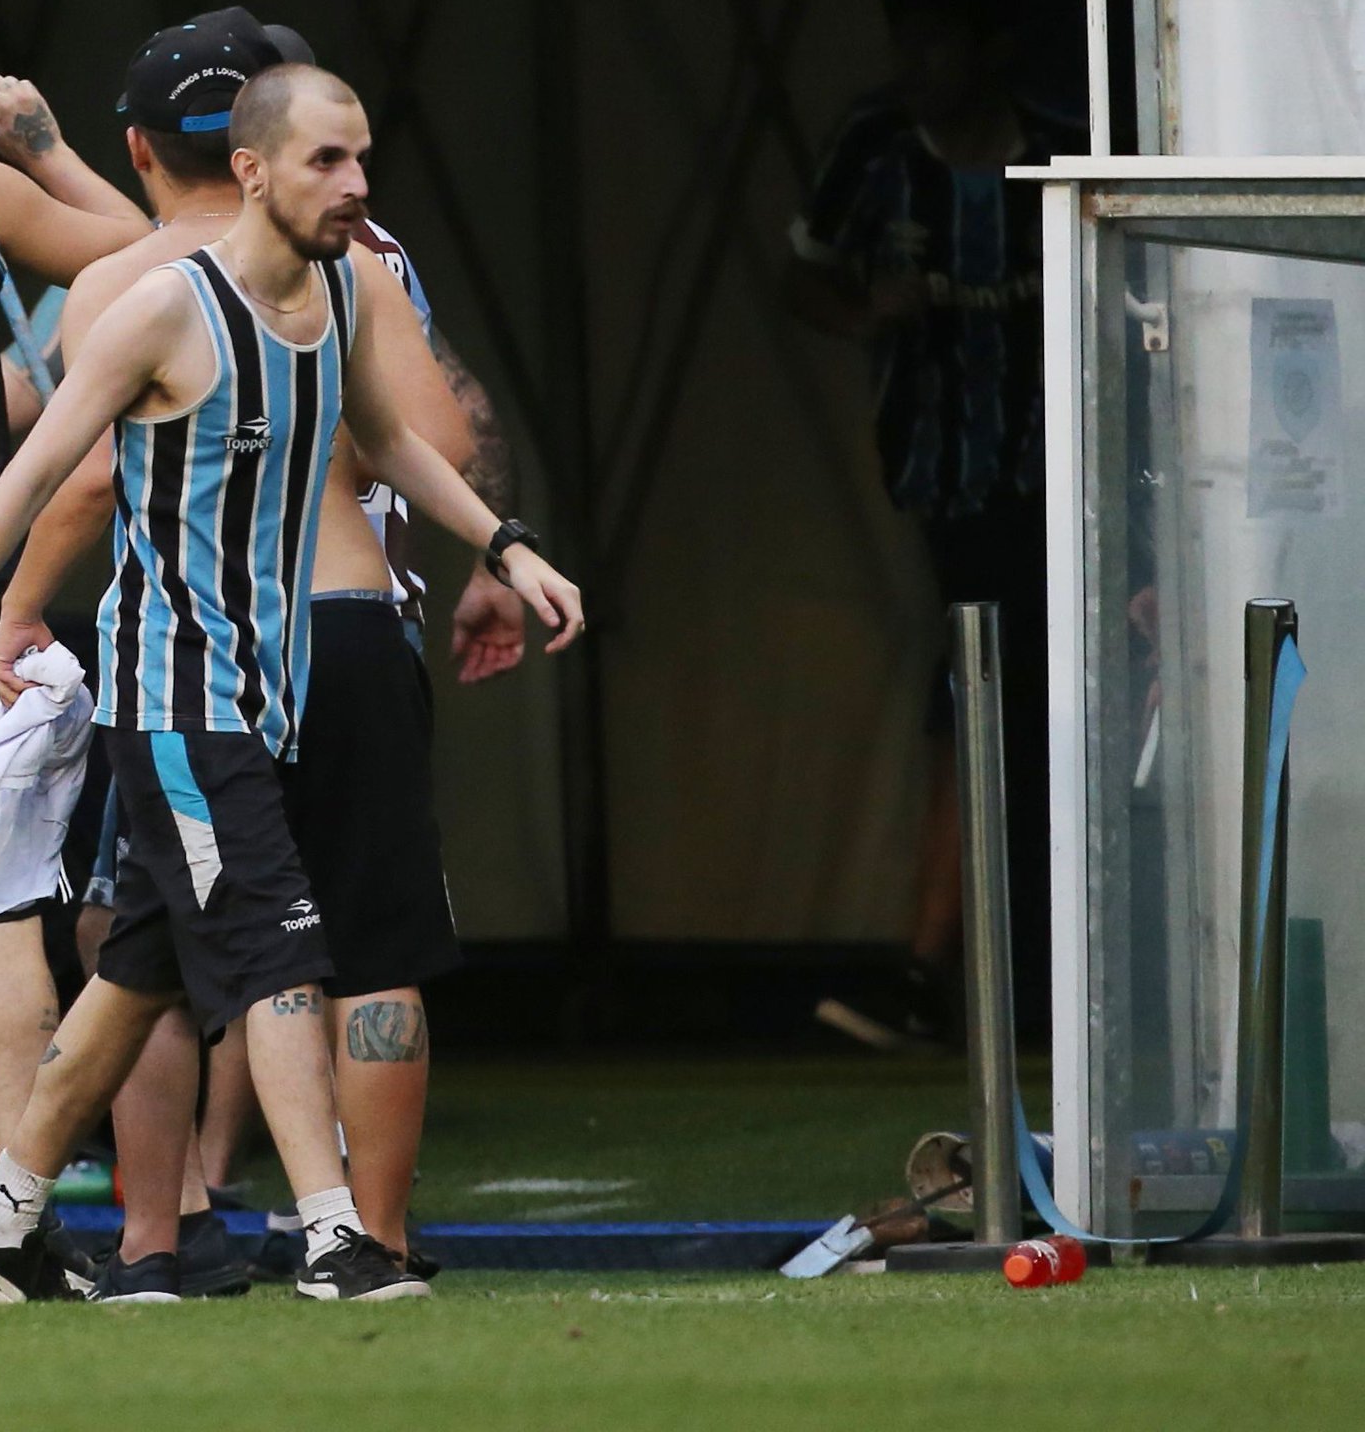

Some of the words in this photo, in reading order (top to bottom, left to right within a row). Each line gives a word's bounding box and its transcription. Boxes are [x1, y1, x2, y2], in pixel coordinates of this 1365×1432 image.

[169, 72, 201, 101] VIVEMOS
[202, 67, 215, 78] DE
[223, 436, 272, 453] Topper
